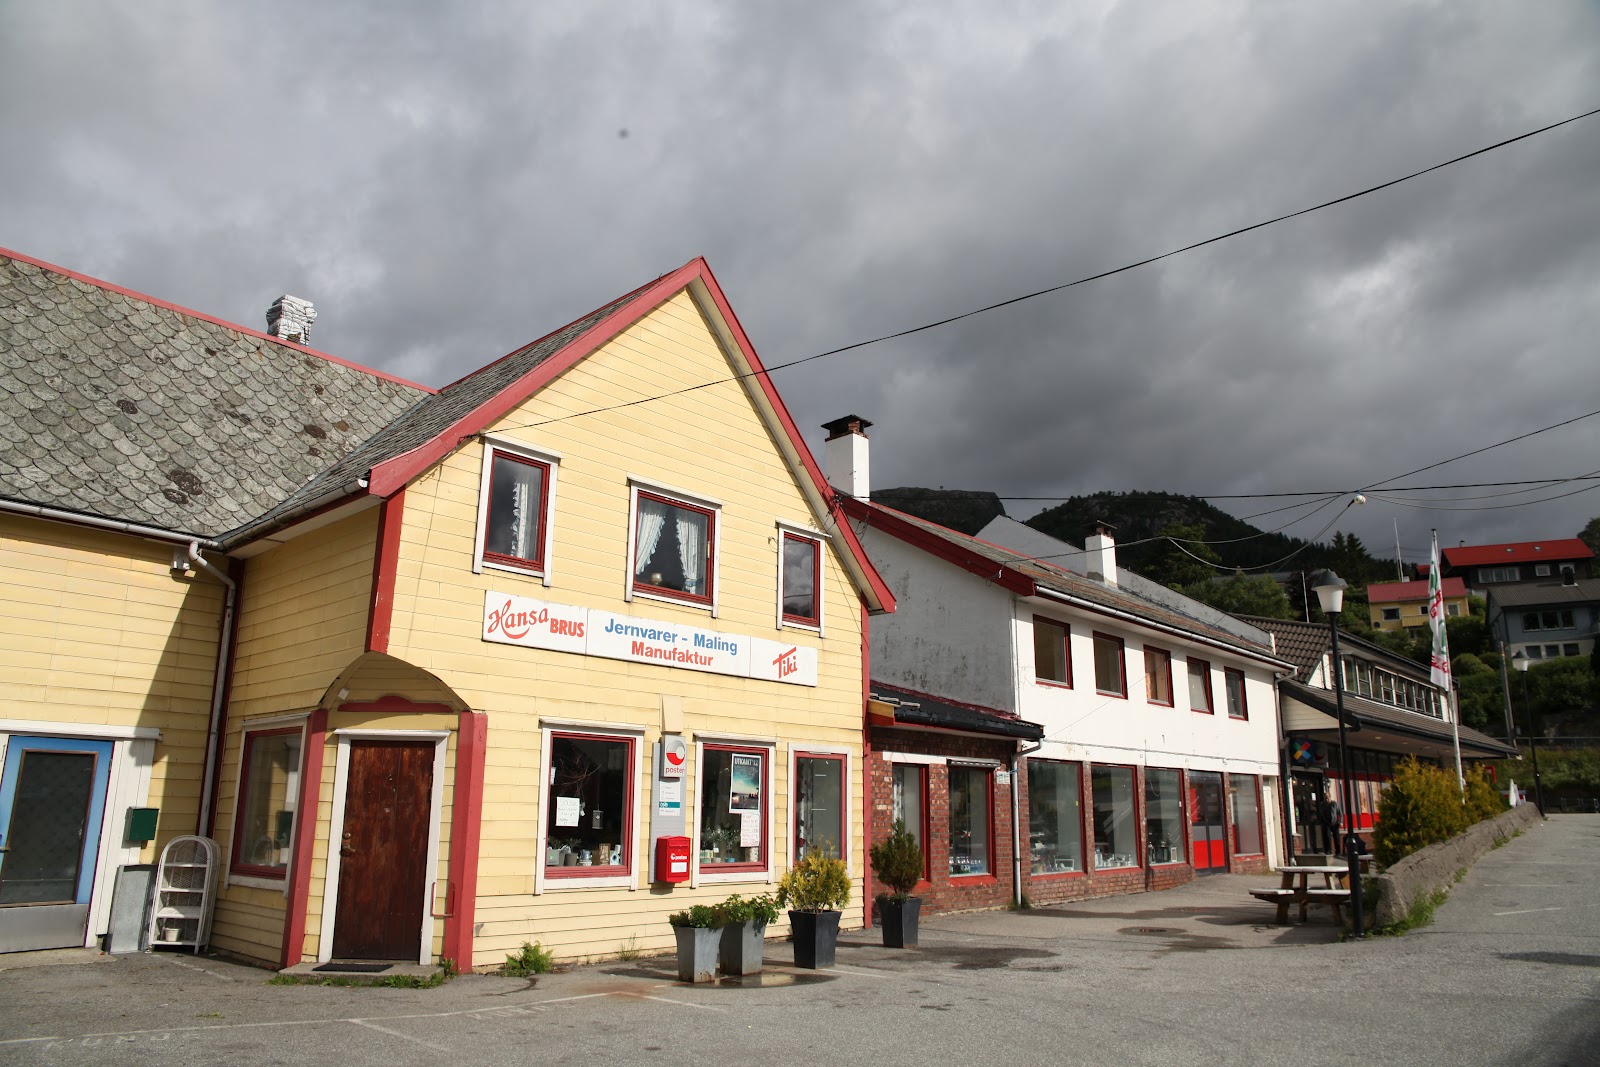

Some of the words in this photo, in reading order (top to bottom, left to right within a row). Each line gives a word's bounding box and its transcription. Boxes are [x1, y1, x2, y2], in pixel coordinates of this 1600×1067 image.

[487, 599, 549, 639] Hansa
[550, 618, 585, 638] BRUS
[605, 618, 678, 643] Jernvarer
[694, 633, 738, 656] Maling
[631, 641, 714, 666] Manufaktur
[772, 646, 798, 679] Tiki
